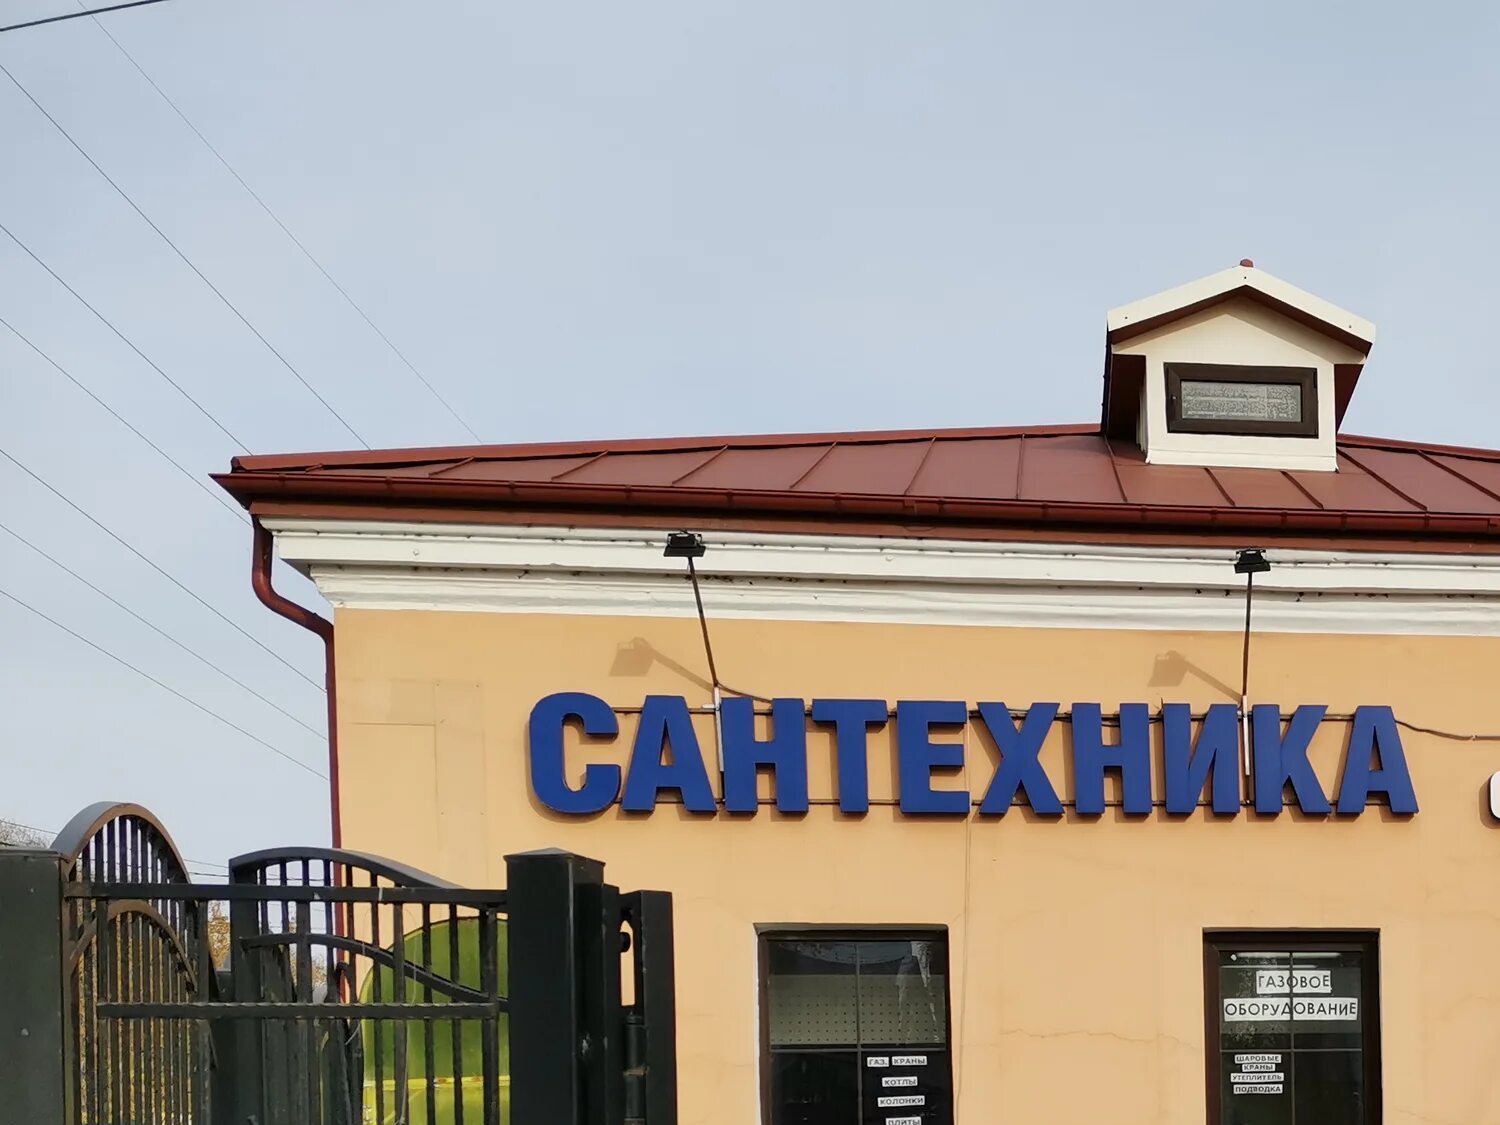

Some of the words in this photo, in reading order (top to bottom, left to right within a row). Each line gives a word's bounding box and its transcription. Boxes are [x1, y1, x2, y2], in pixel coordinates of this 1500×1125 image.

[528, 691, 1420, 817] САНТЕХНИКА
[1257, 975, 1330, 988] ГАЗОВОЕ
[1224, 1002, 1357, 1016] ОБОРУДОВАНИЕ
[868, 1058, 888, 1066] ГАЗ.
[893, 1057, 926, 1065] КРАНЫ
[884, 1078, 917, 1086] КОТЛЫ
[879, 1097, 924, 1105] КОЛОНКИ
